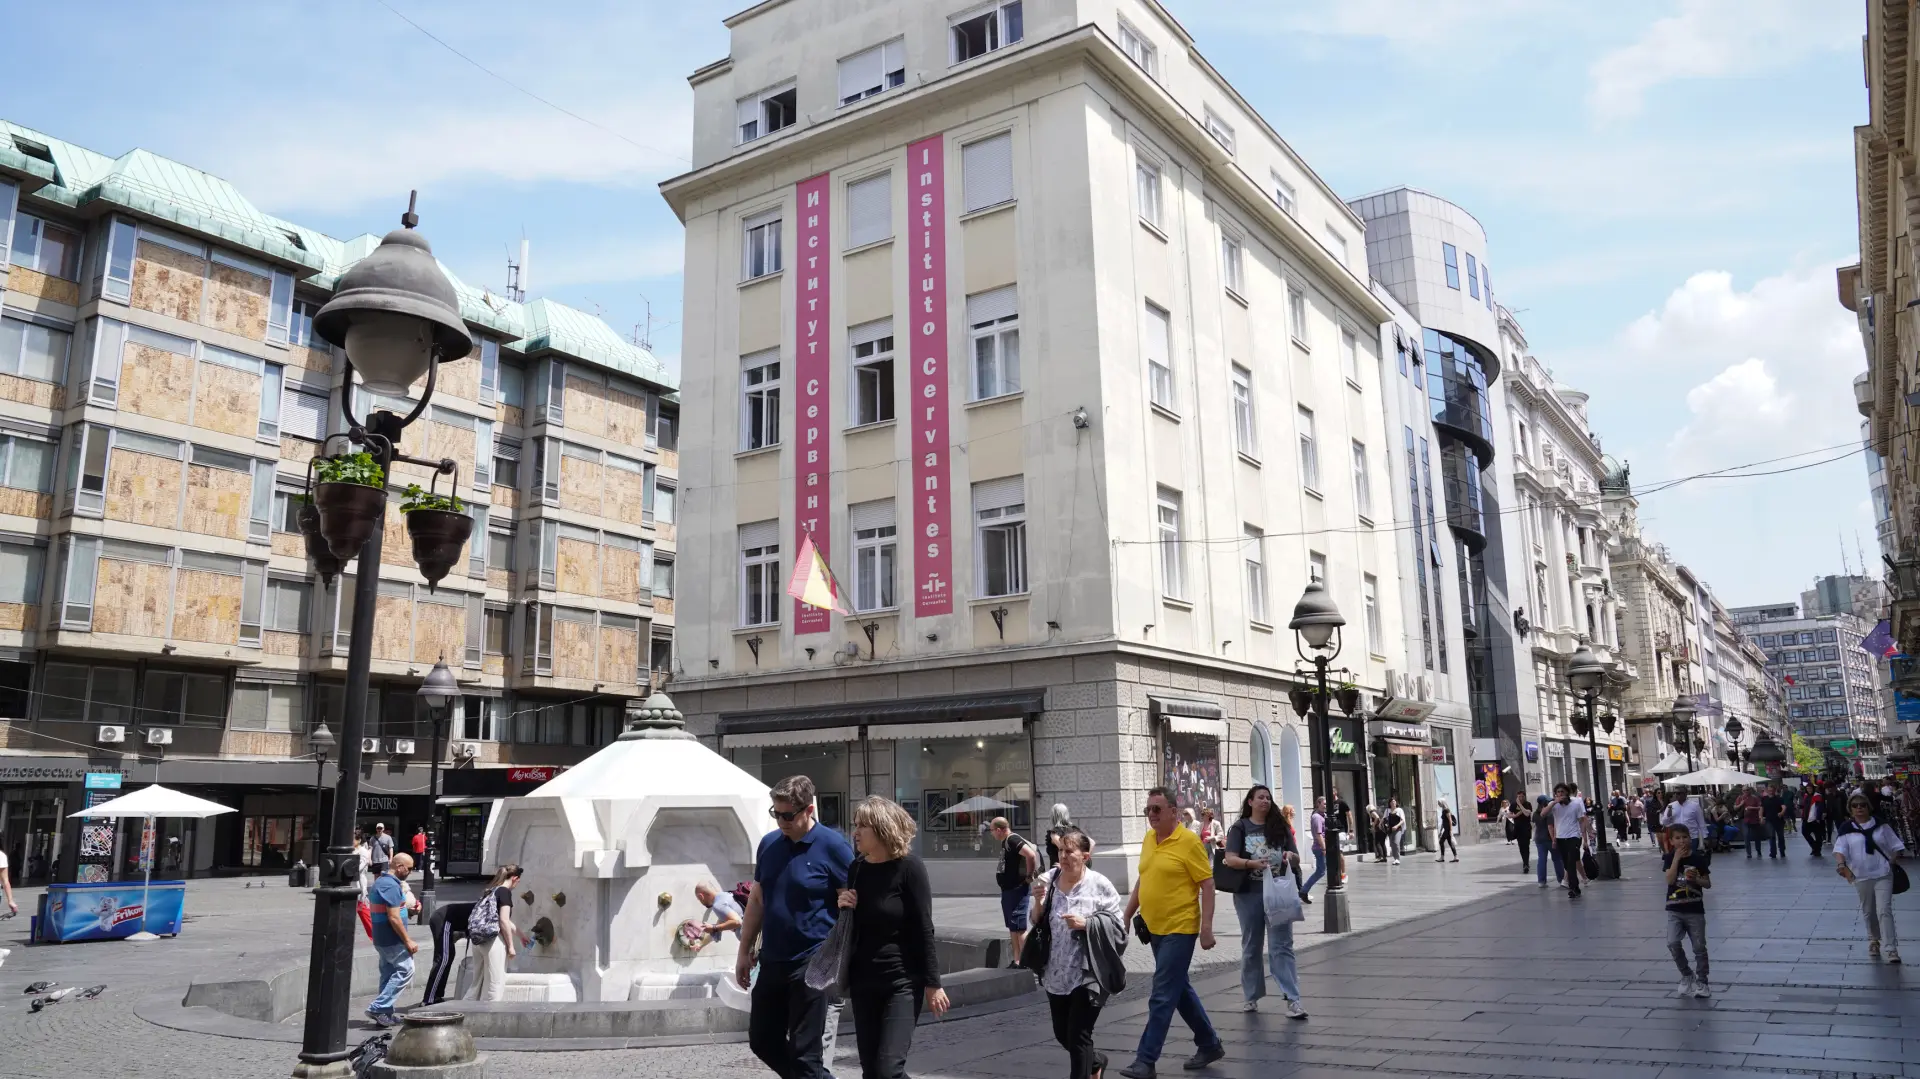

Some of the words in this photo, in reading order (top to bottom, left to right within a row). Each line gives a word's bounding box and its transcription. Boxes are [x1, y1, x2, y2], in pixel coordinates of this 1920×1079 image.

[807, 190, 819, 354] Институт
[920, 148, 935, 336] Instituto
[806, 379, 819, 532] Сервант
[922, 357, 939, 558] Cervantes
[357, 797, 398, 810] UVENIRS
